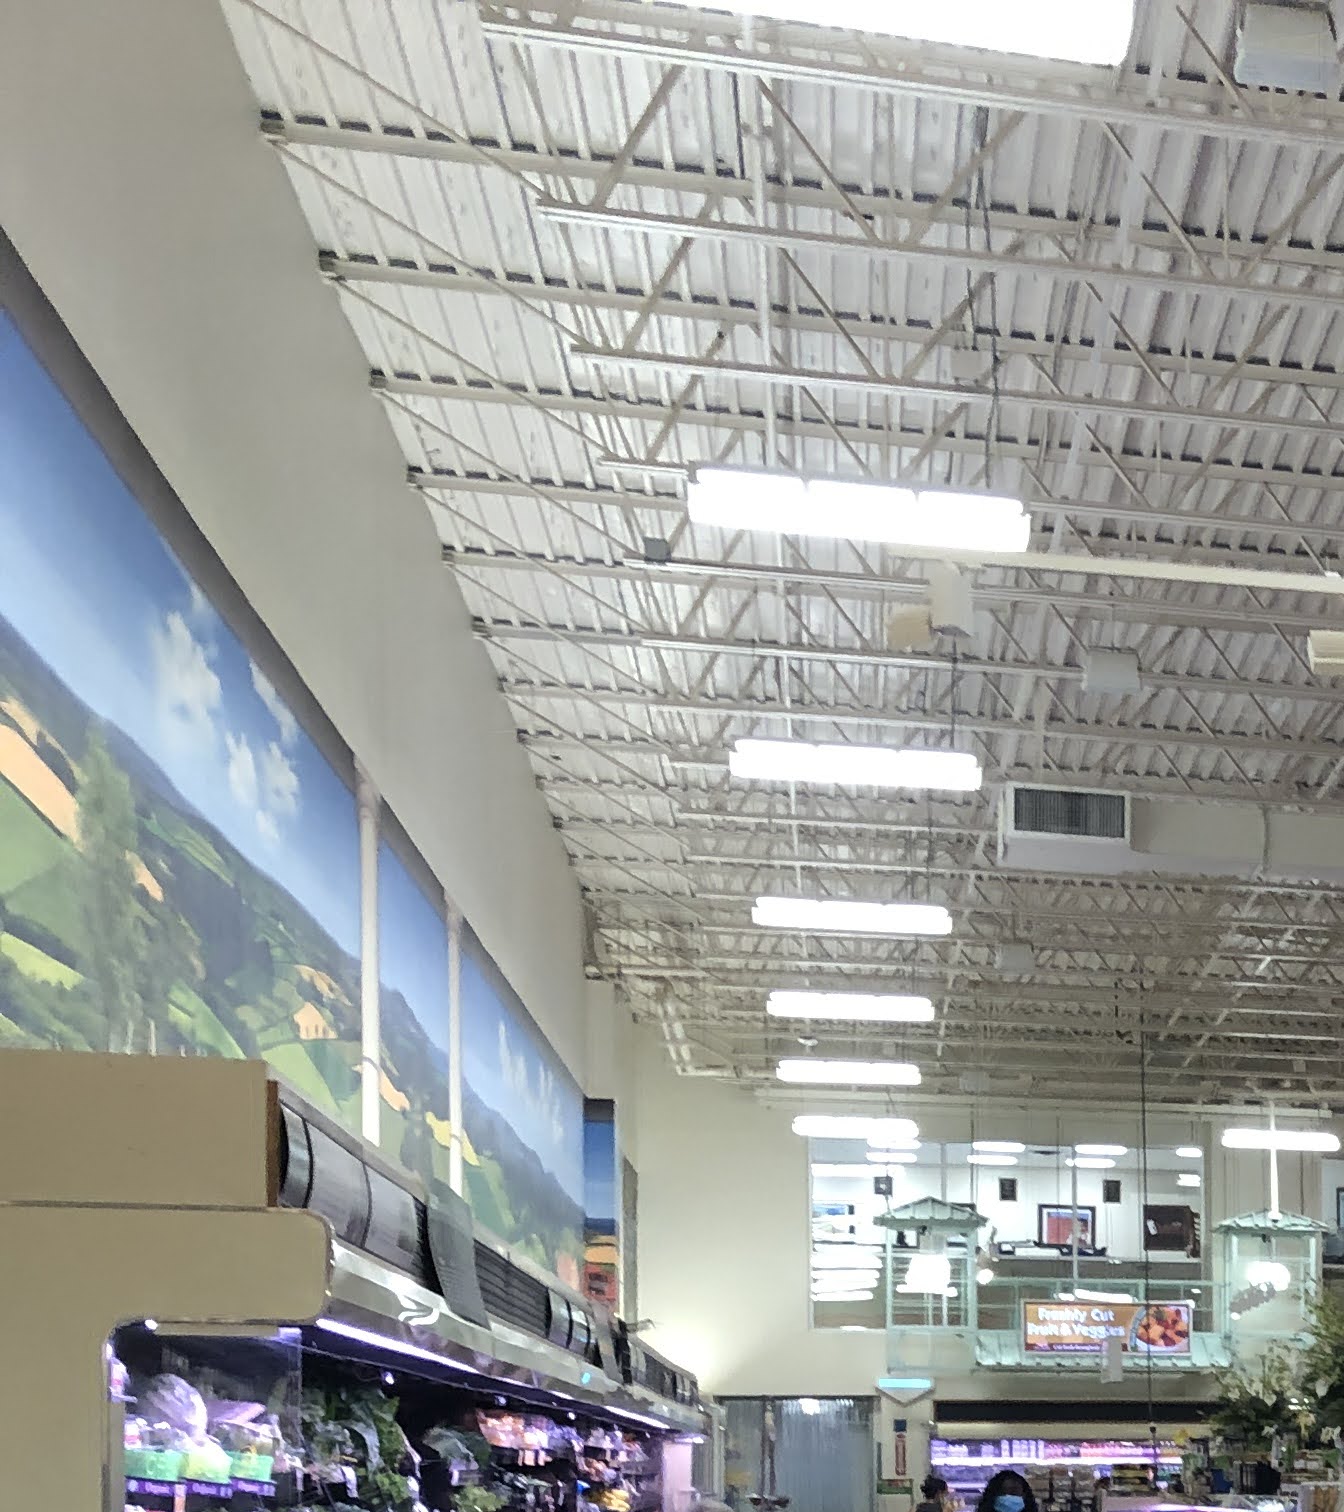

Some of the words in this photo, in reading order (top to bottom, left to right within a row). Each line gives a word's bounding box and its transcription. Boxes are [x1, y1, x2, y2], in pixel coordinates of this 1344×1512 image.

[1038, 1307, 1087, 1323] Freshly
[1091, 1308, 1114, 1322] Cut
[1027, 1322, 1059, 1336] Fruit
[1060, 1323, 1071, 1335] &
[1072, 1323, 1125, 1338] Veggies
